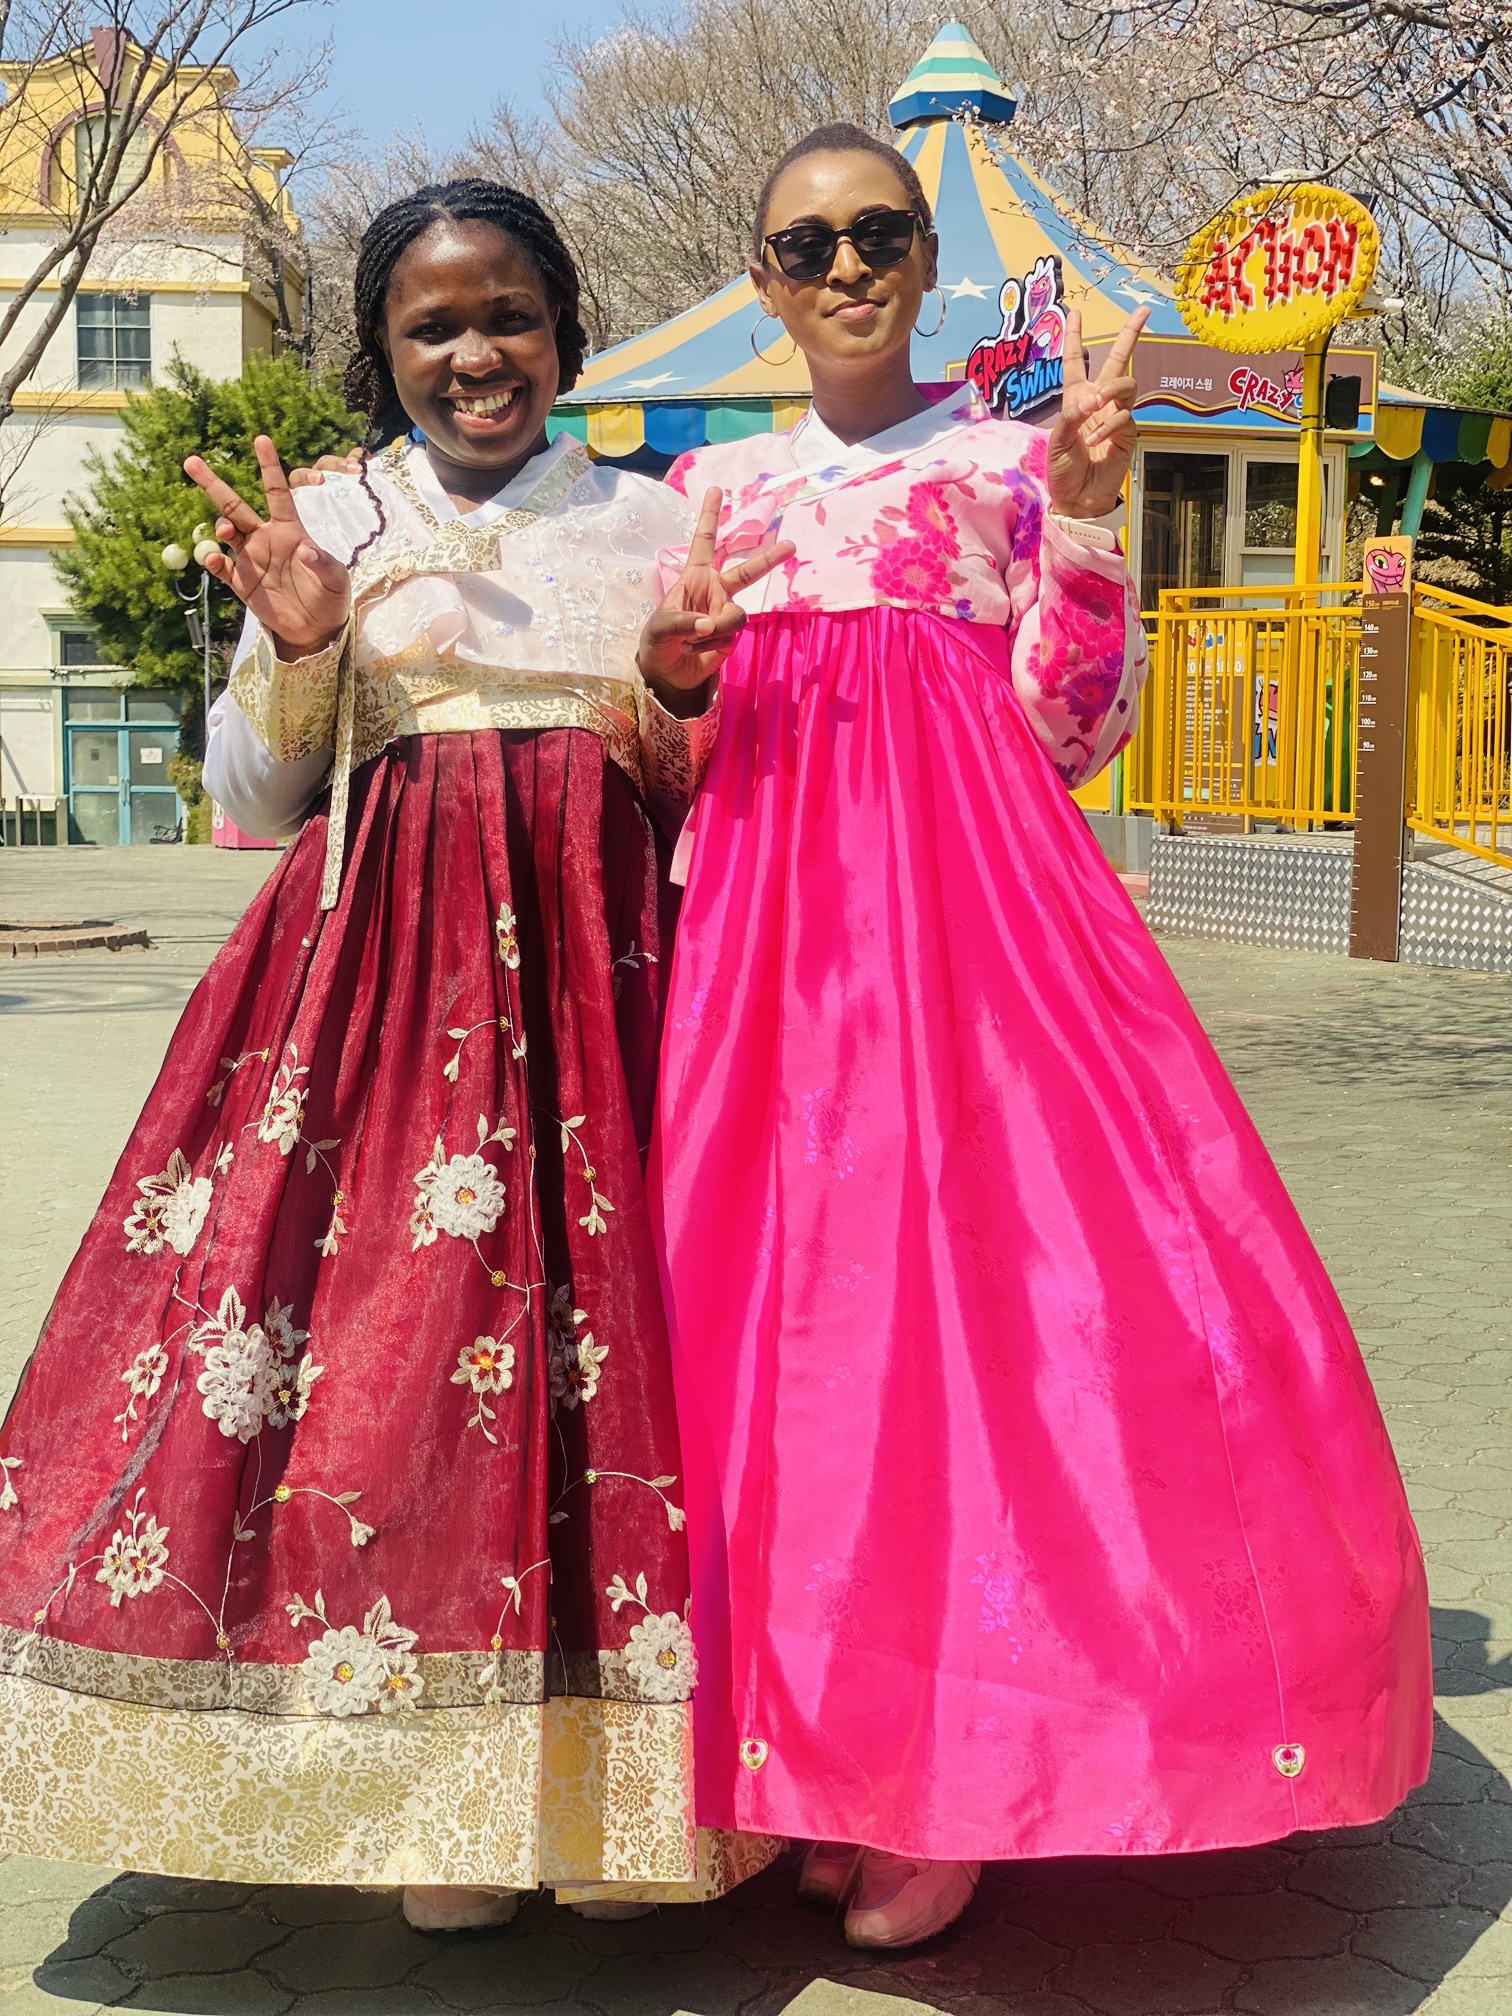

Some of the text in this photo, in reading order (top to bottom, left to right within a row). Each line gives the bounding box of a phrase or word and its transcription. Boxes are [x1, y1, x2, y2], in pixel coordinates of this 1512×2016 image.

[1202, 204, 1358, 317] ACTION
[966, 333, 1031, 401] CRAZY
[1160, 376, 1213, 391] 크레이지 스윙
[1228, 367, 1296, 412] CRAZY
